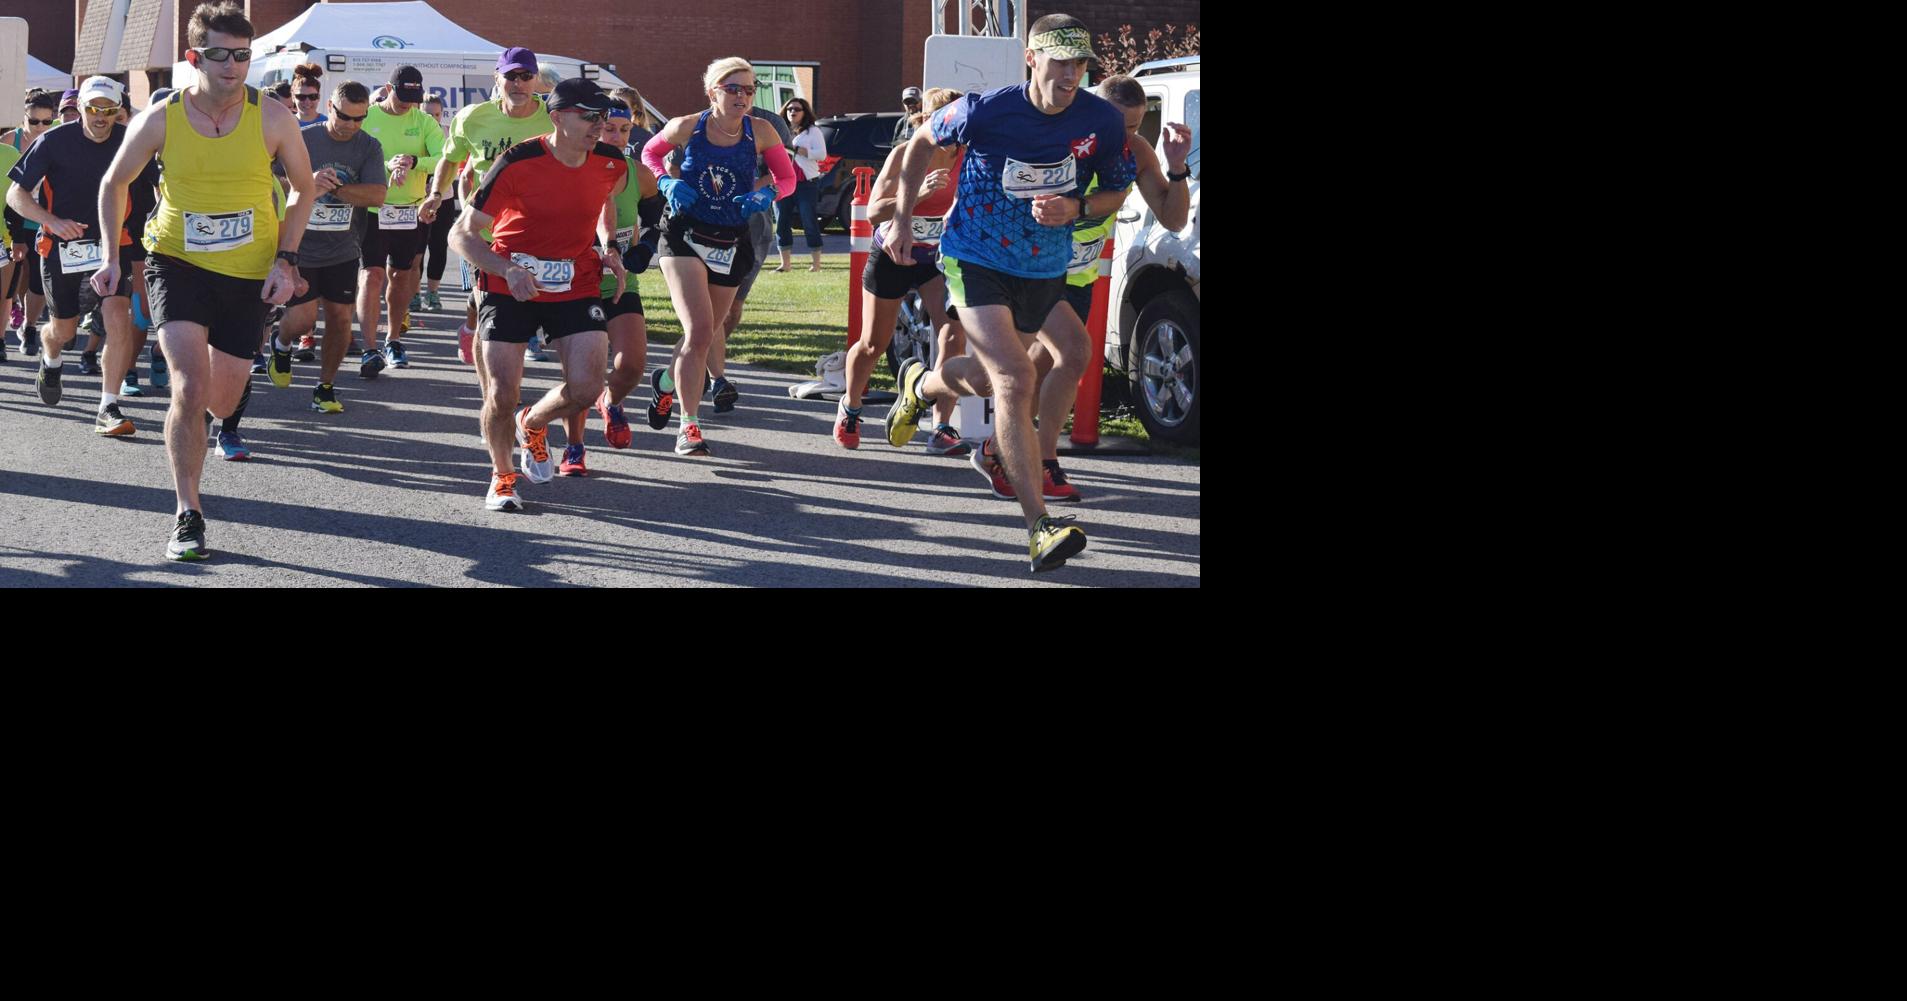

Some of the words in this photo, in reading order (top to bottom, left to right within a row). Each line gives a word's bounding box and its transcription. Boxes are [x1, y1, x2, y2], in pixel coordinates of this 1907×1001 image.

[1043, 162, 1073, 185] 227
[329, 208, 351, 222] 293
[398, 208, 416, 221] 259
[219, 216, 251, 238] 279
[927, 222, 943, 238] 24
[541, 261, 571, 281] 229
